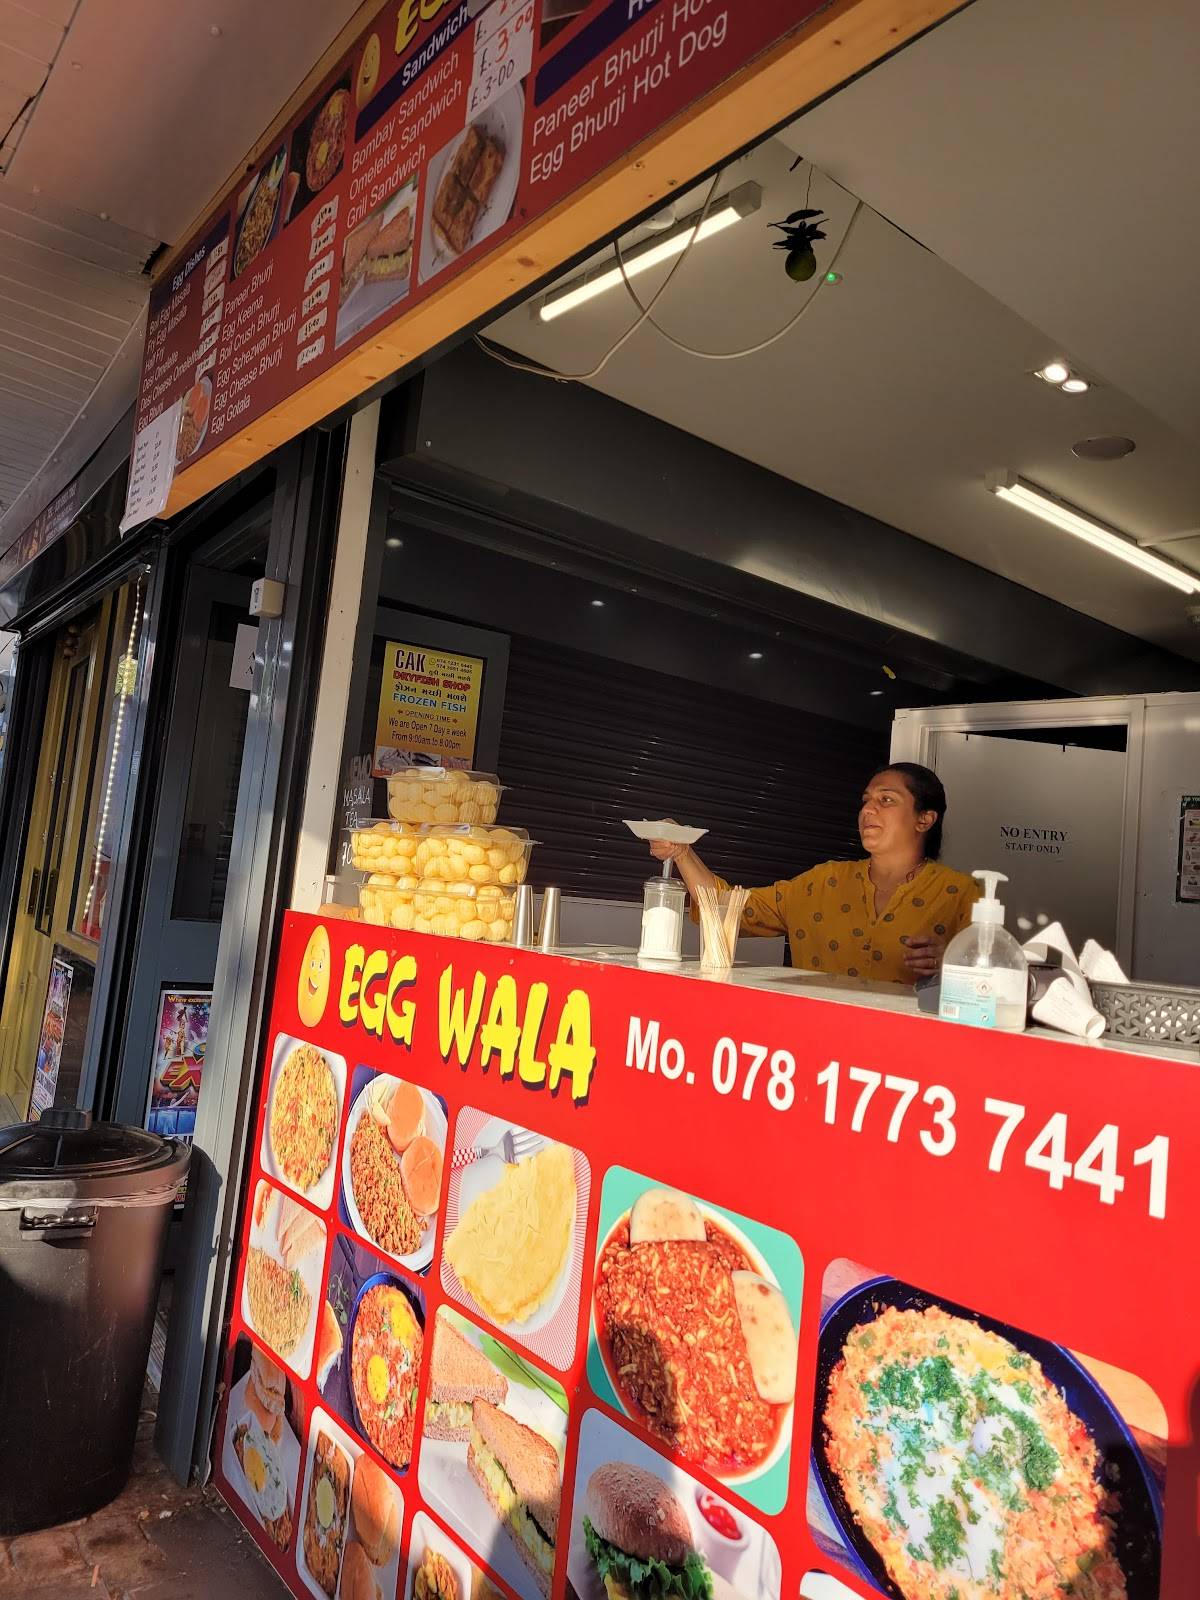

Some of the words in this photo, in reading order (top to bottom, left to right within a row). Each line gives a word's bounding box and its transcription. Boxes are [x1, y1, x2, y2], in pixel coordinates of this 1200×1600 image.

[402, 5, 468, 86] Sandwich
[530, 141, 564, 184] Egg
[570, 85, 626, 152] Bhurji
[633, 51, 671, 104] Hot
[679, 10, 728, 68] Dog
[533, 75, 599, 147] Paneer
[604, 14, 664, 88] Bhurji
[672, 0, 713, 32] Ho
[350, 143, 398, 200] Omelette
[401, 78, 462, 150] Sandwich
[352, 116, 396, 173] Bombay
[399, 50, 459, 124] Sandwich
[347, 191, 368, 229] Grill
[370, 142, 426, 207] Sandwich
[172, 270, 184, 293] Egg
[184, 245, 206, 277] Dishes
[224, 285, 250, 319] Paneer
[251, 257, 274, 293] Bhurji
[219, 340, 233, 365] Boil
[233, 321, 256, 352] Crush
[257, 297, 281, 332] Bhurji
[222, 321, 236, 343] Egg
[237, 295, 264, 328] Keema
[216, 367, 231, 388] Egg
[231, 333, 270, 375] Schezwan
[272, 306, 297, 342] Bhurji
[214, 391, 228, 411] Egg
[229, 367, 258, 398] Cheese
[259, 342, 284, 375] Bhurji
[210, 414, 226, 434] Egg
[395, 649, 426, 673] CAK
[442, 679, 472, 692] SHOP
[388, 717, 399, 727] We
[400, 719, 409, 729] are
[411, 720, 428, 732] Open
[433, 724, 445, 737] Day
[451, 728, 467, 739] week
[393, 693, 437, 708] FROZEN
[441, 701, 467, 713] FISH
[405, 709, 434, 720] OPENING
[436, 715, 451, 723] TIME
[391, 731, 408, 742] From
[432, 737, 439, 747] to
[345, 811, 359, 829] TEA
[1000, 826, 1020, 838] NO
[1023, 828, 1069, 842] ENTRY
[1004, 842, 1034, 852] STAFF
[1036, 844, 1063, 855] ONLY
[339, 943, 418, 1052] EGG
[438, 963, 597, 1109] WALA
[625, 1016, 696, 1085] Mo.
[711, 1036, 797, 1112] 078
[816, 1060, 958, 1157] 1773
[983, 1096, 1171, 1220] 7441
